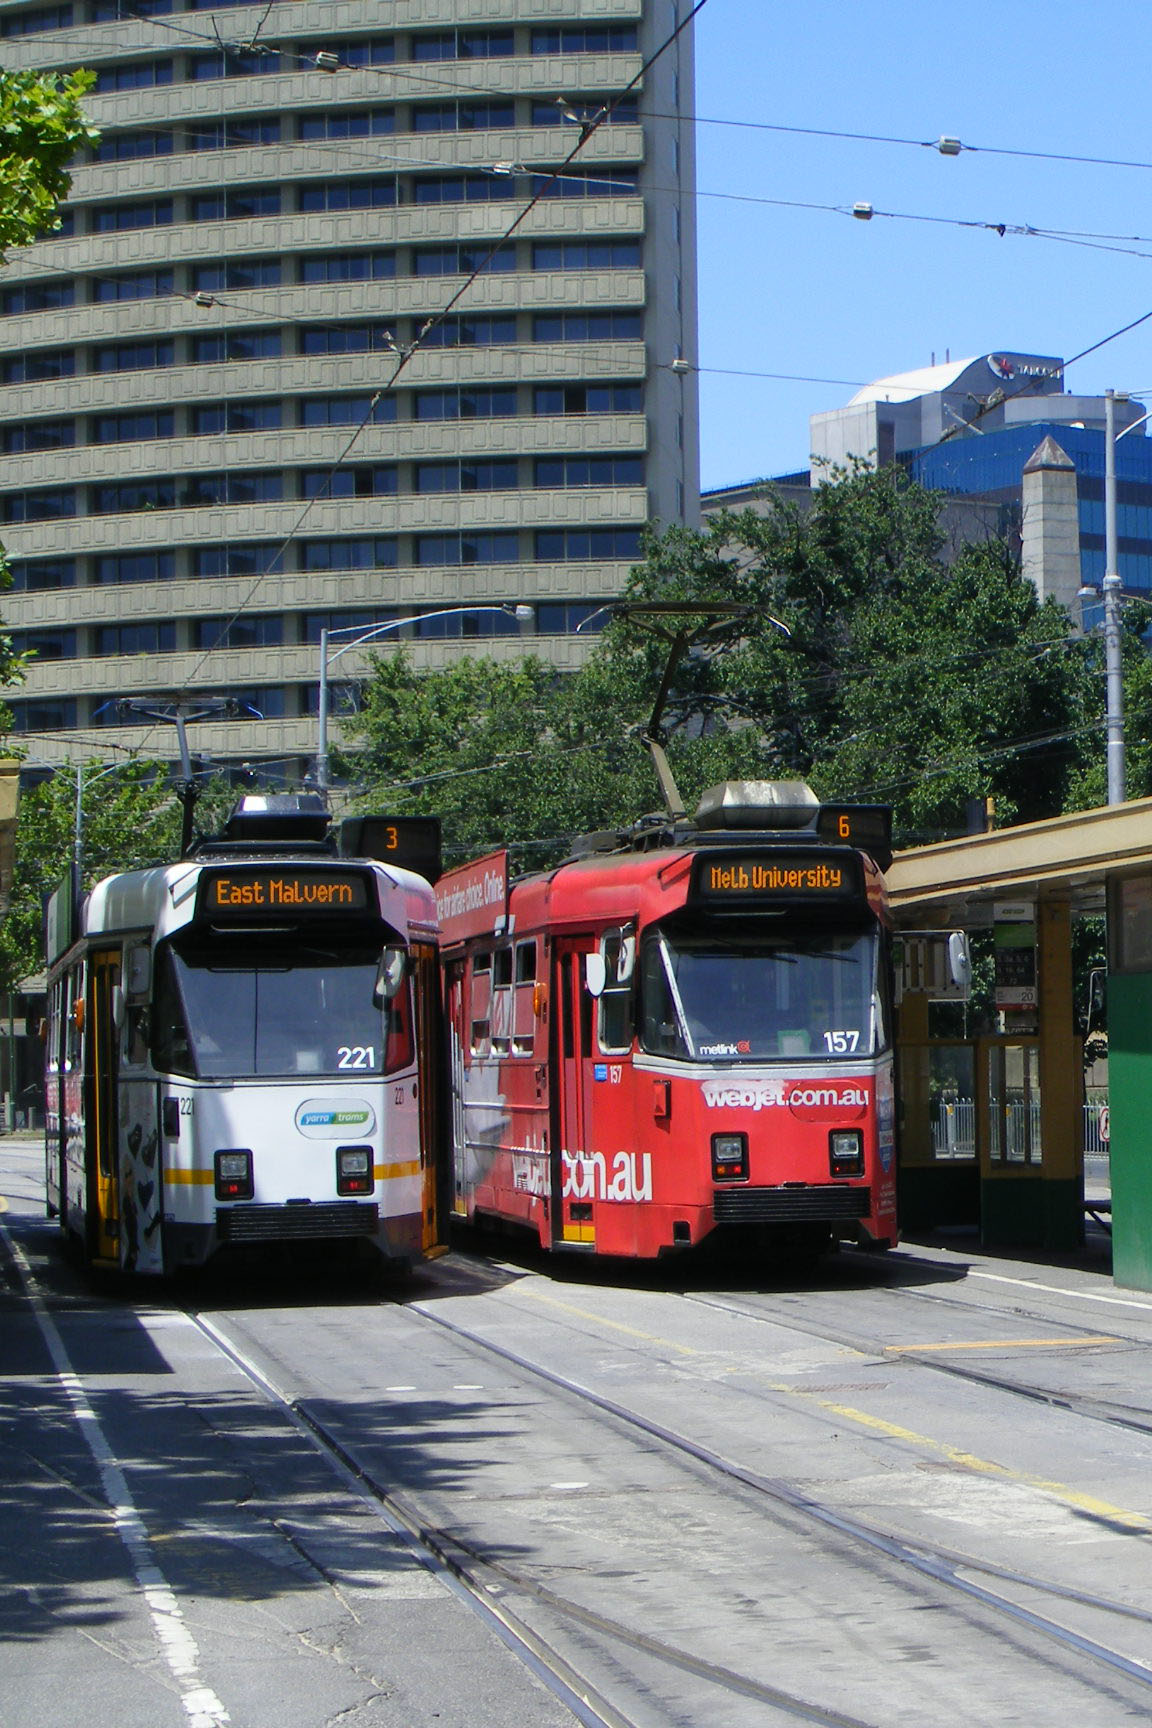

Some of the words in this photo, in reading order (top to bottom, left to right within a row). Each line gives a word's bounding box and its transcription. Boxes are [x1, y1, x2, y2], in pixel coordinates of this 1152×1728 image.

[386, 826, 398, 849] 3
[838, 815, 850, 838] 6
[711, 866, 749, 889] Melb
[752, 864, 842, 888] University
[216, 879, 265, 905] East
[269, 879, 353, 904] Malvern
[699, 1043, 738, 1055] metlink
[823, 1031, 860, 1053] 157
[337, 1047, 375, 1069] 221
[181, 1098, 195, 1116] 221
[305, 1114, 330, 1124] yarra
[338, 1113, 364, 1122] trams
